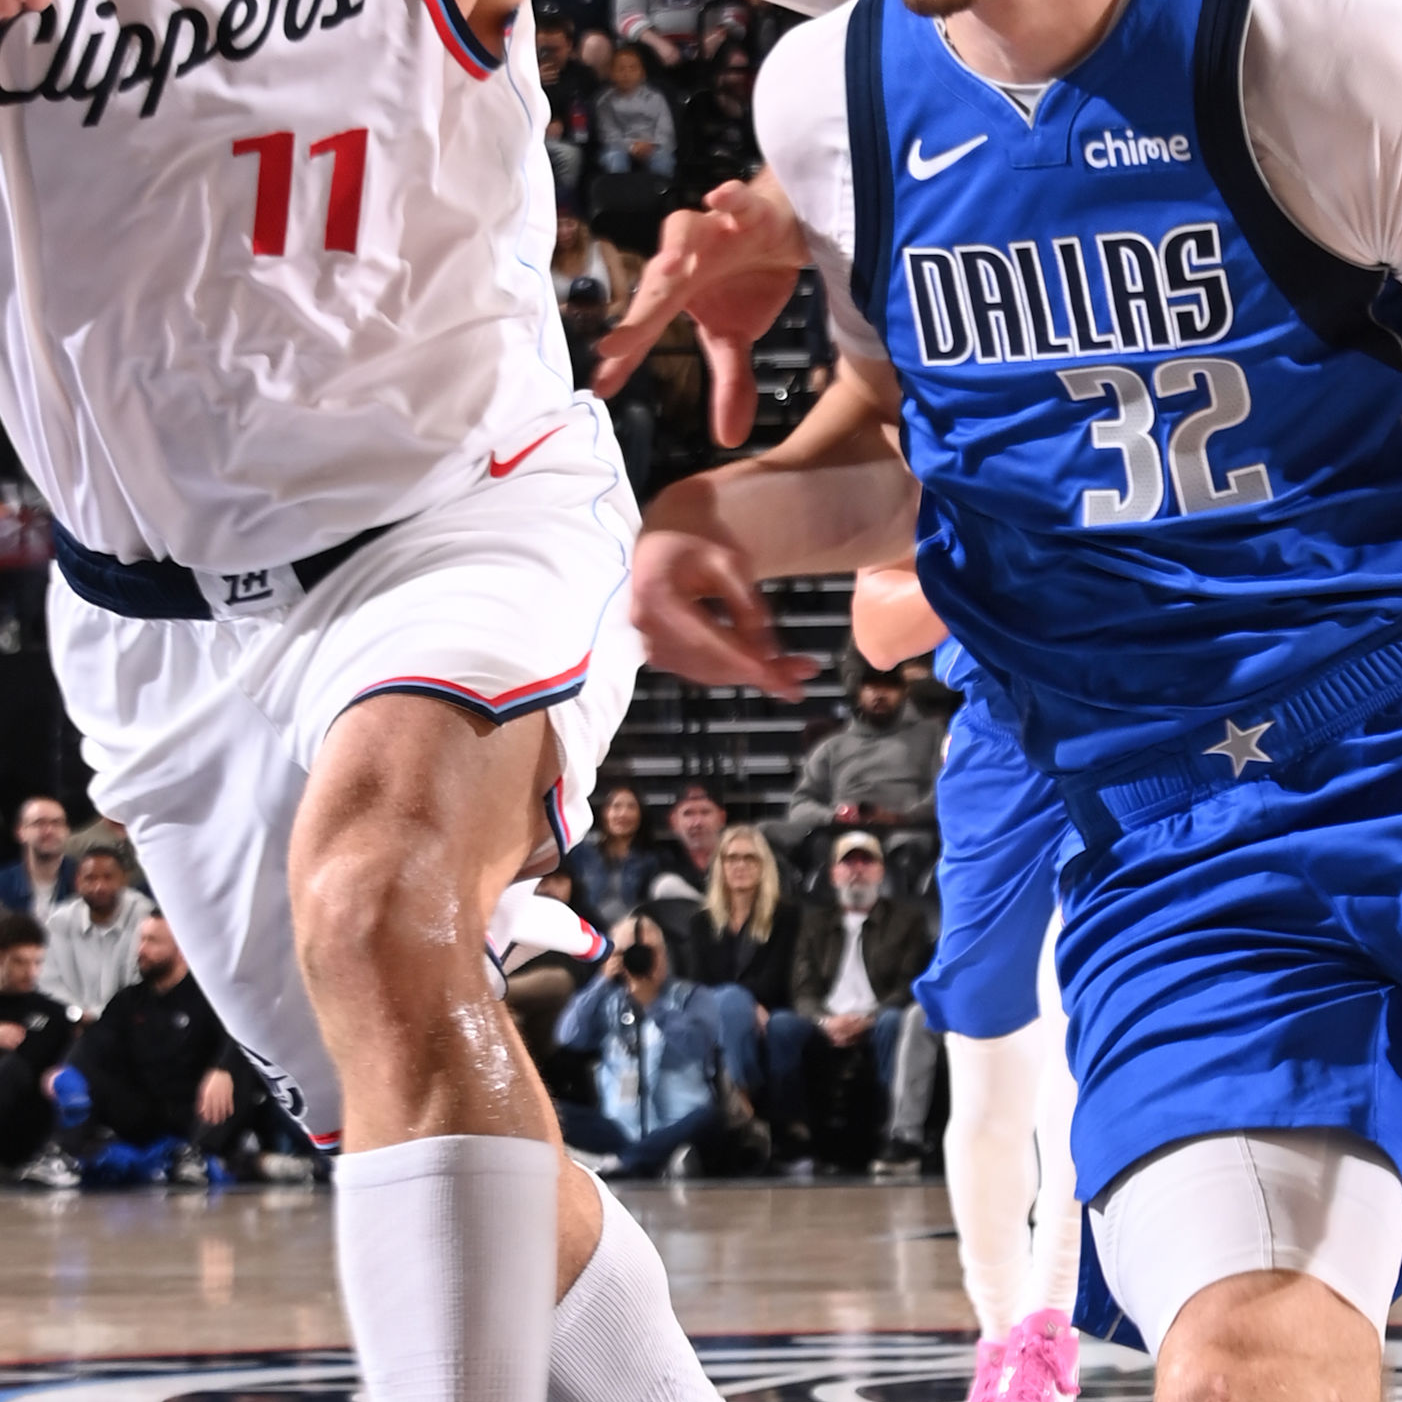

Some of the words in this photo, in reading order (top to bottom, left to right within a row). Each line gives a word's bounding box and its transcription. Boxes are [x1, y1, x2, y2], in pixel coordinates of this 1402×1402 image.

[232, 127, 369, 257] 11
[1084, 129, 1192, 169] chime
[902, 222, 1234, 367] DALLAS
[1056, 357, 1274, 528] 32
